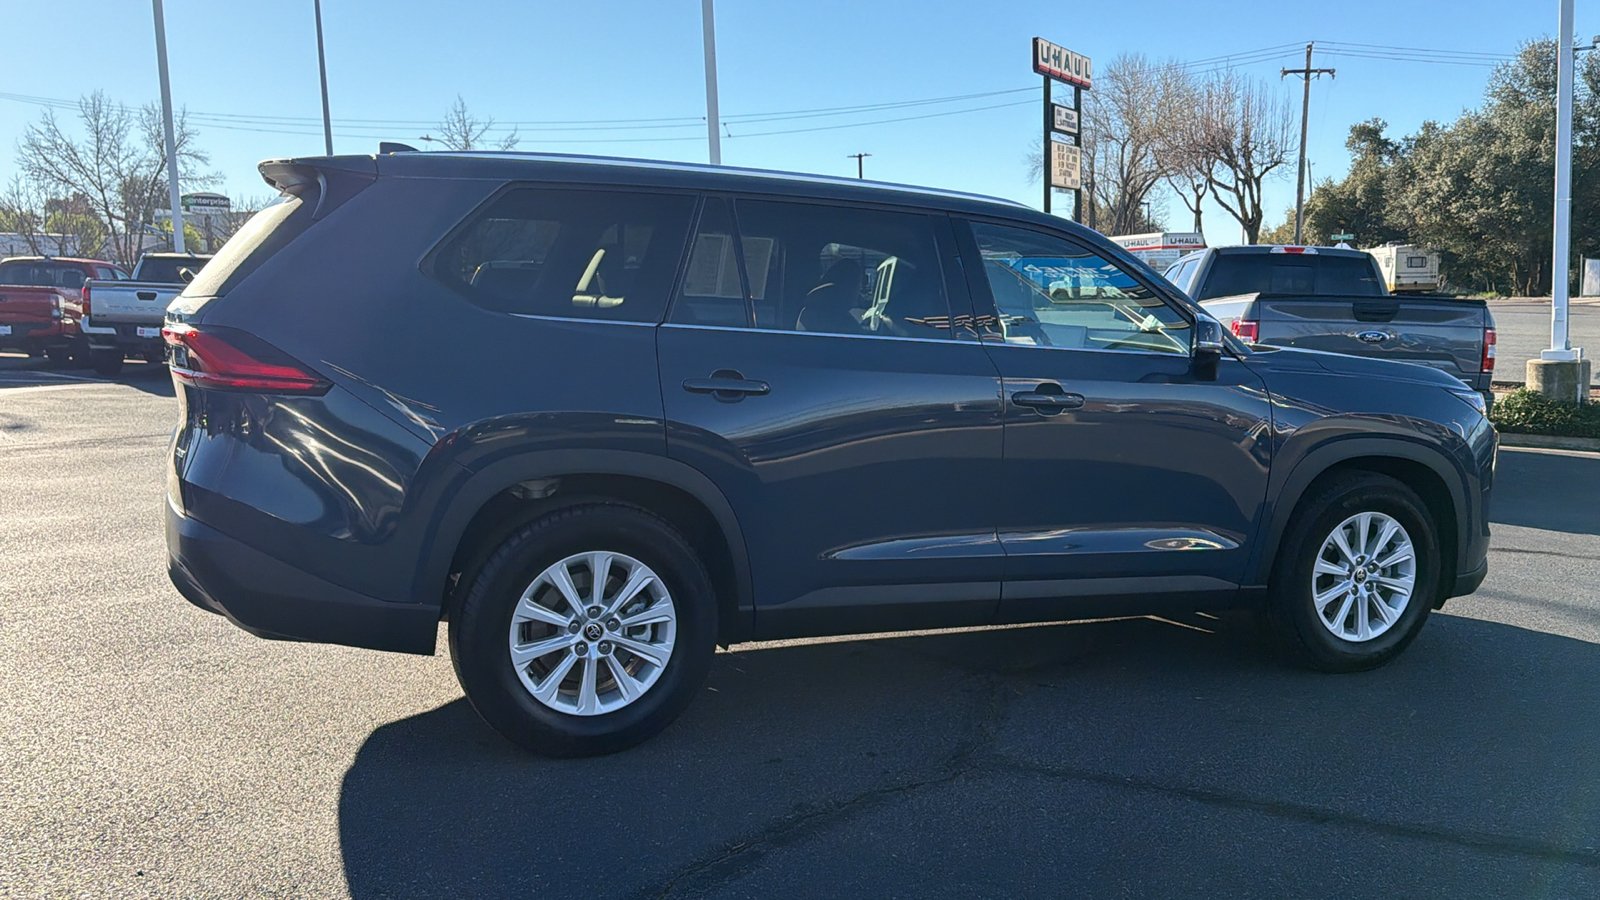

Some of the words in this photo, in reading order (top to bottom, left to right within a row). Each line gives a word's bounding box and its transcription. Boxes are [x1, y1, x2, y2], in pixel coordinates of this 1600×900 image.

[1040, 42, 1091, 80] U-HAUL
[188, 197, 229, 206] enterprise
[1123, 239, 1150, 248] U-HAUL
